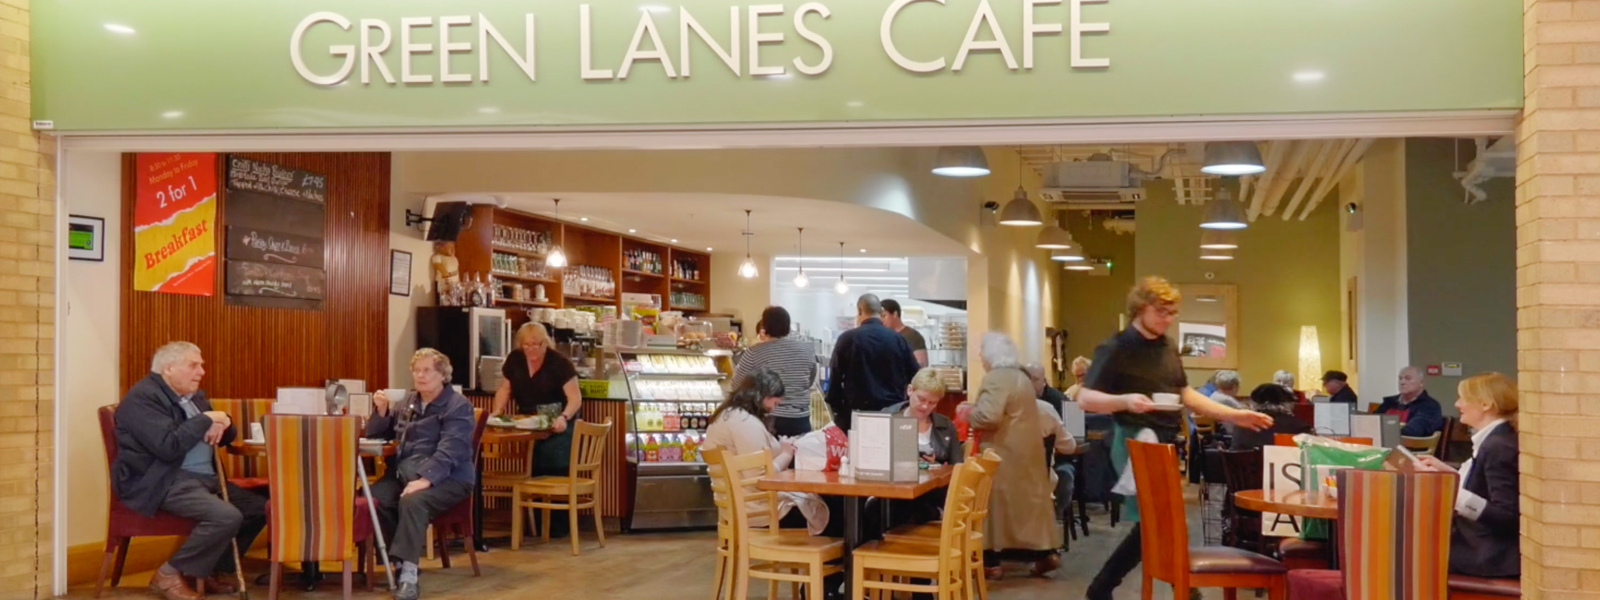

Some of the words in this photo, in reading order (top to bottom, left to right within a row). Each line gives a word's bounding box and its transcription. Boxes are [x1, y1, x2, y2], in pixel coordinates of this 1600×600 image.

[290, 11, 536, 85] GREEN
[579, 2, 834, 79] LANES
[149, 171, 173, 184] Monday
[180, 159, 198, 170] Friday
[156, 191, 168, 208] 2
[168, 184, 187, 202] for
[188, 176, 197, 190] 1
[144, 218, 208, 270] Breakfast
